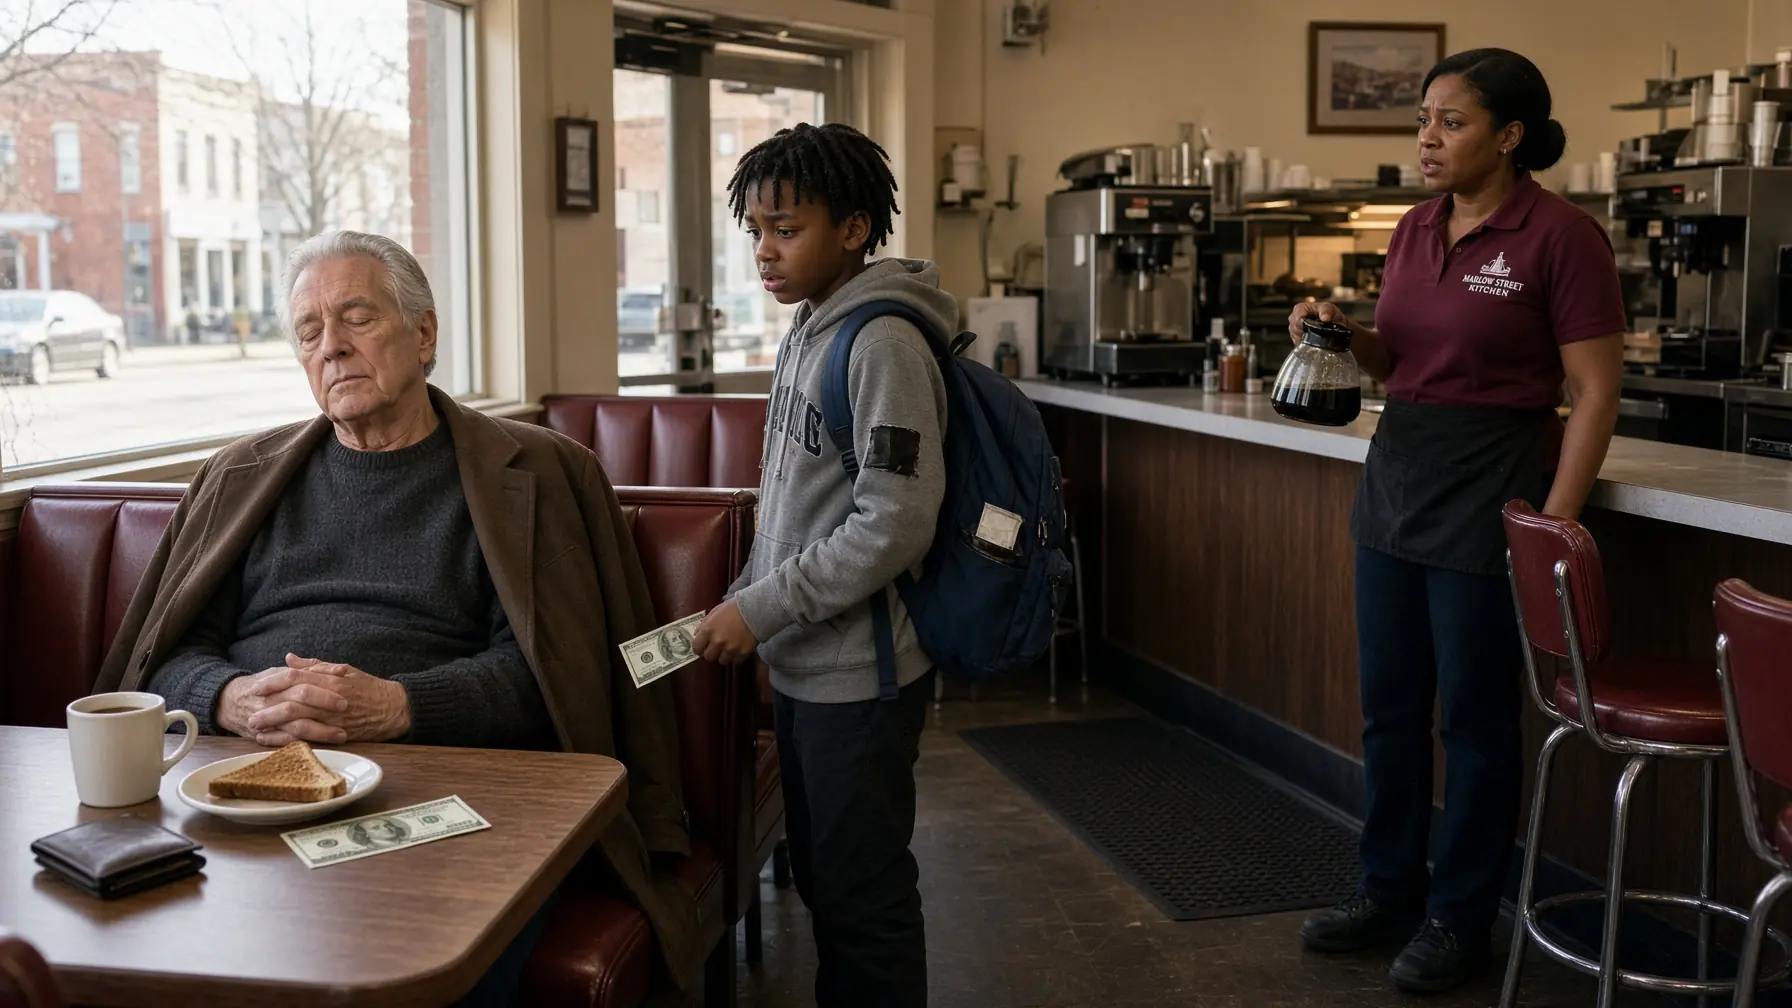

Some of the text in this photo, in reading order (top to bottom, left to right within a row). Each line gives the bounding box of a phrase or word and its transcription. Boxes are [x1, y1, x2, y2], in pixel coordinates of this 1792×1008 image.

[1462, 274, 1524, 291] MARLOW STREET
[1468, 284, 1509, 297] KITCHEN
